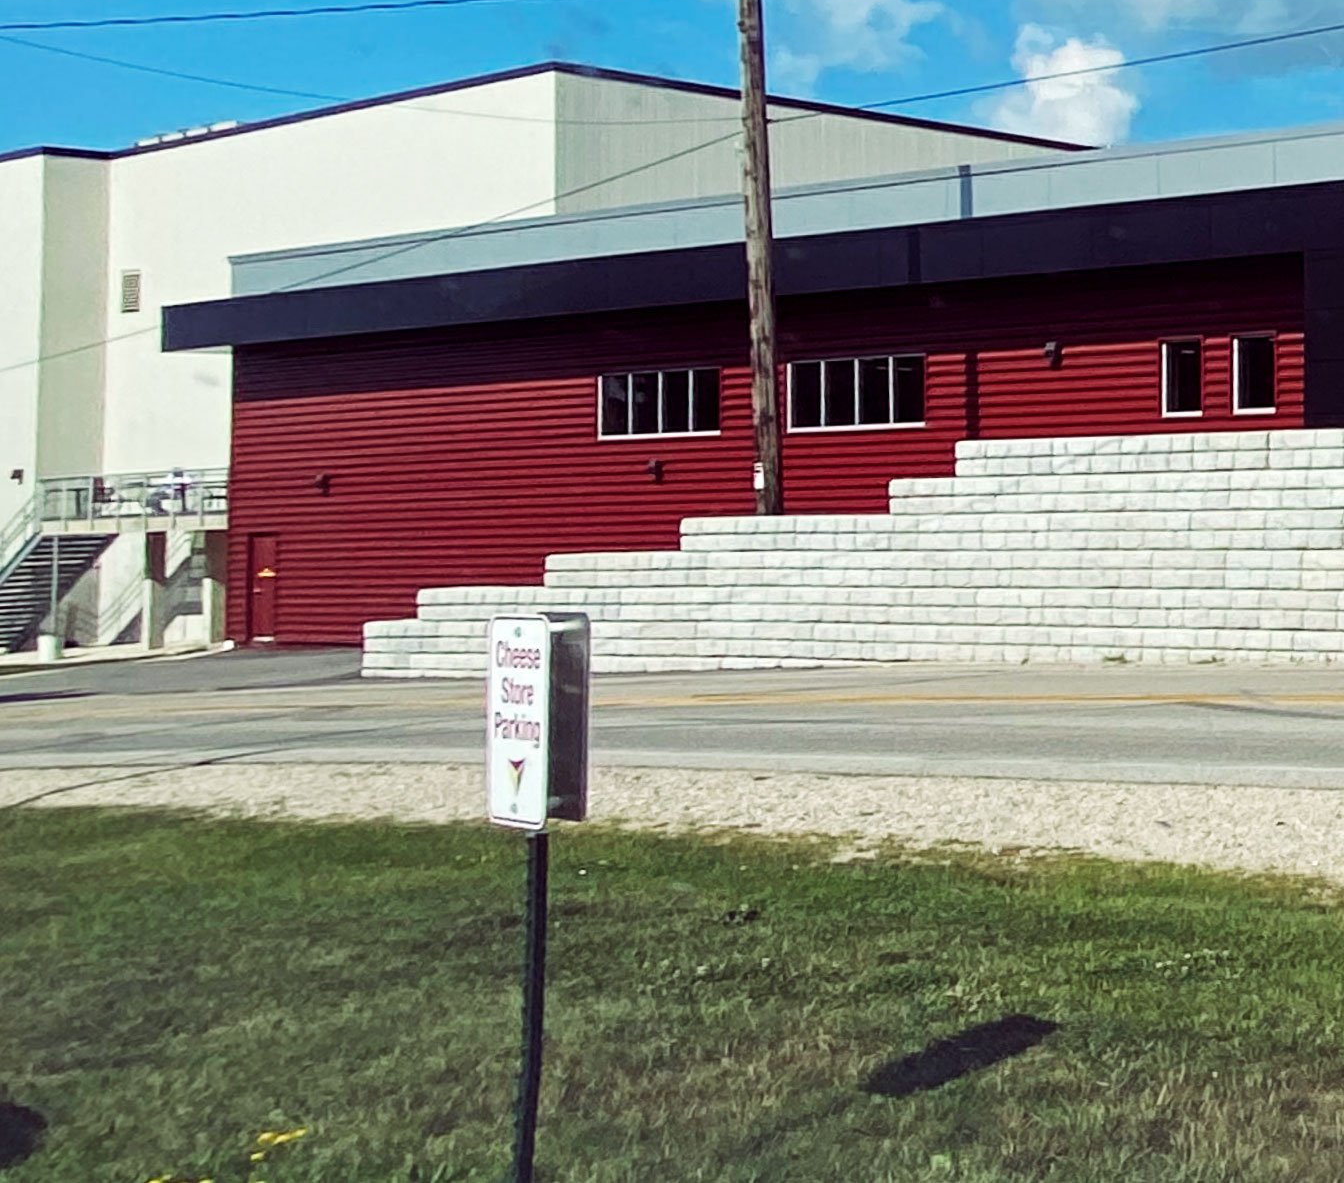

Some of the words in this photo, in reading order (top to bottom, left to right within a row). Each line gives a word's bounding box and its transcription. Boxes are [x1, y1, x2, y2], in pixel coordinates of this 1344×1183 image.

[496, 640, 541, 669] Cheese
[501, 677, 535, 706] Store
[494, 711, 541, 749] Parking
